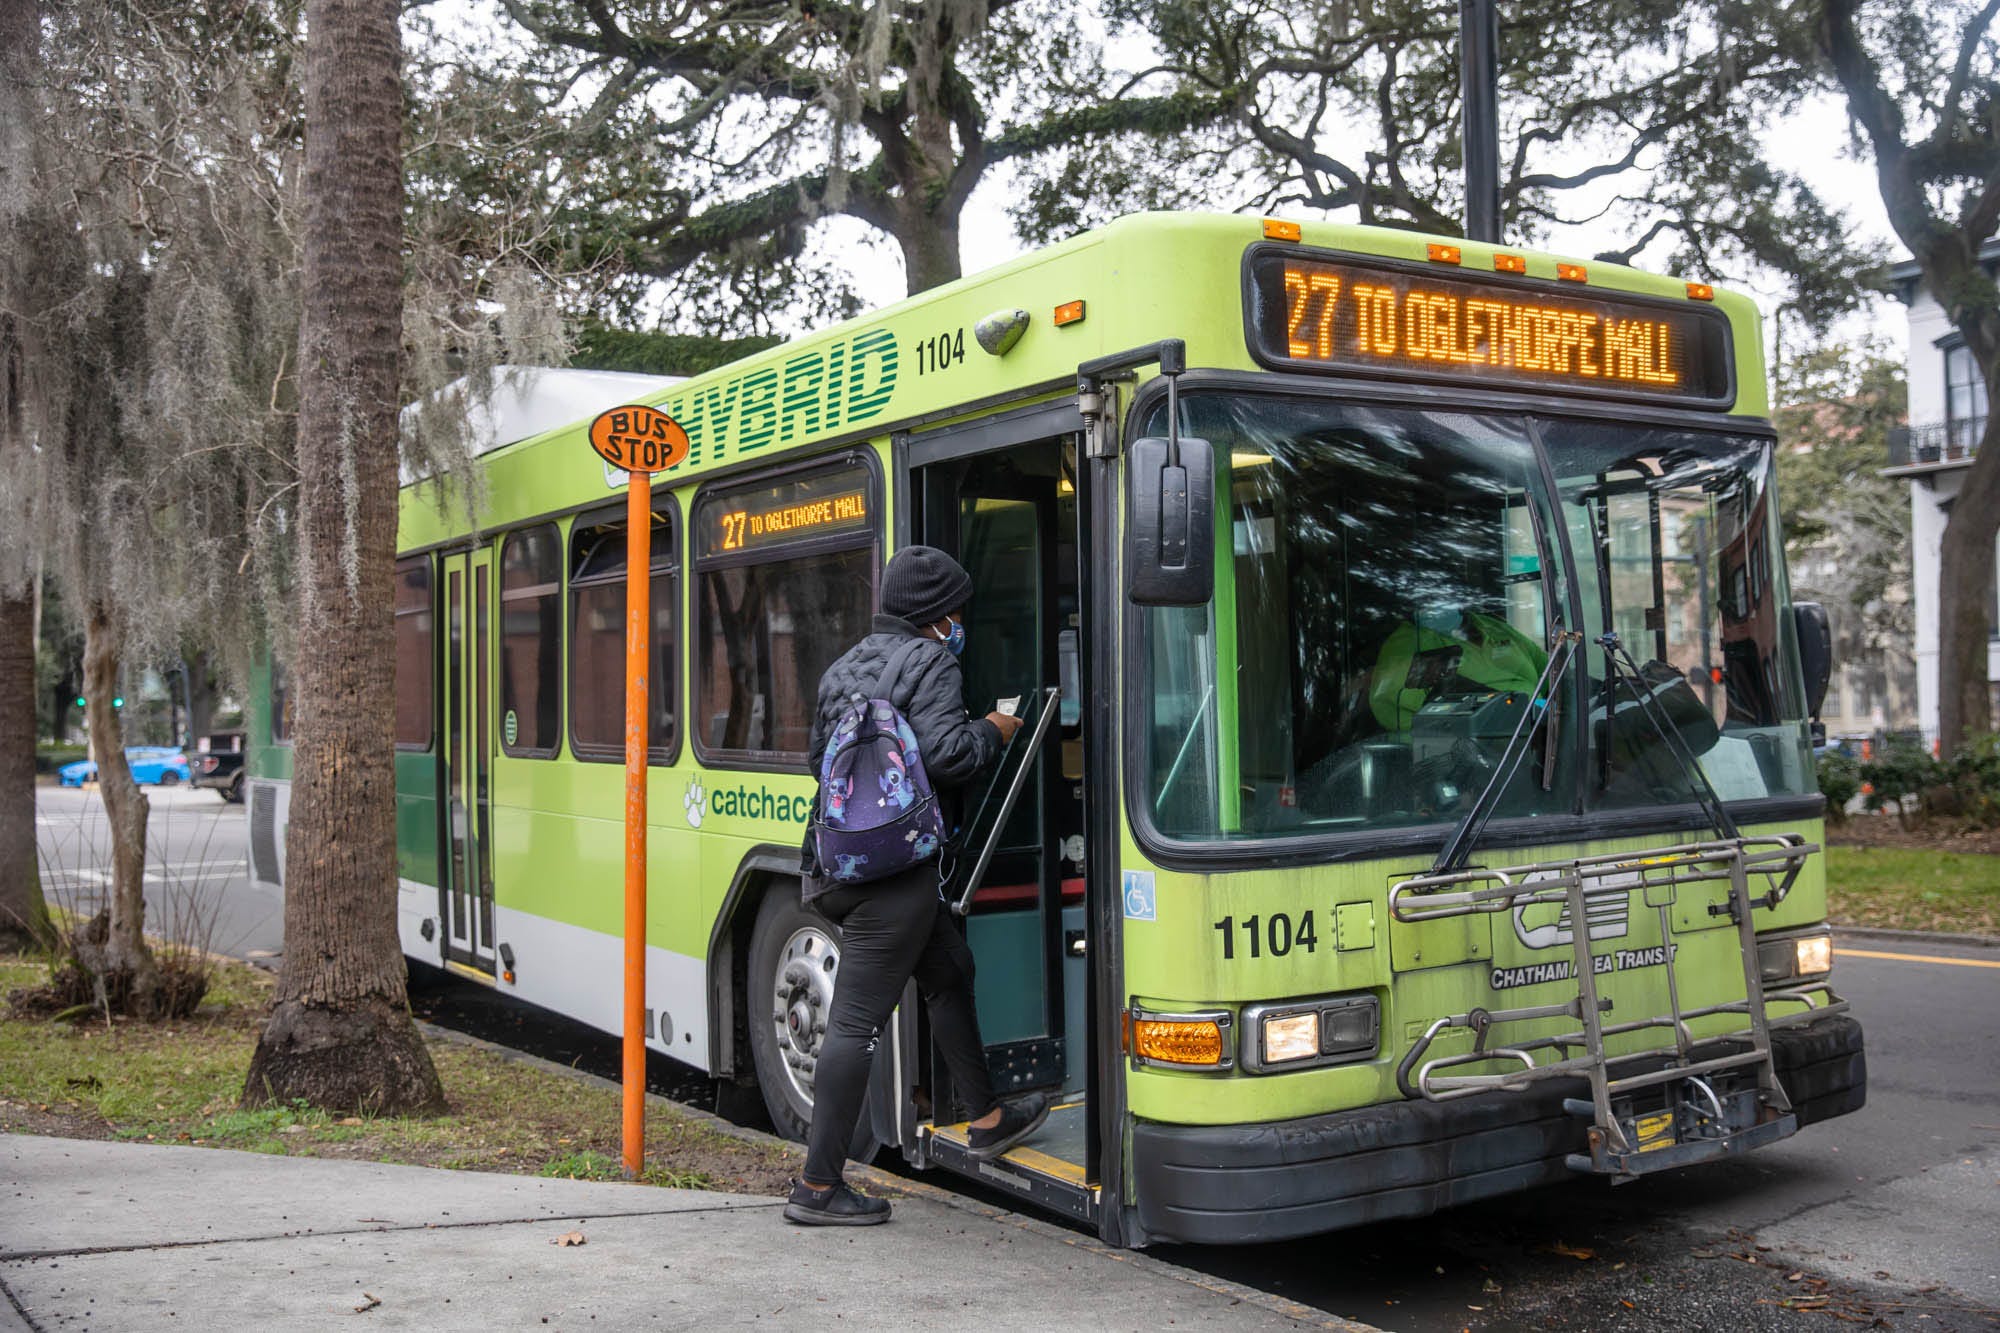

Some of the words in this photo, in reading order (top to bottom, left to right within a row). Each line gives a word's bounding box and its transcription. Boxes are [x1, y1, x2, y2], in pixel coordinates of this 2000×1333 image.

[916, 327, 965, 376] 1104
[1285, 271, 1339, 358] 27
[1353, 285, 1395, 353] TO
[1406, 293, 1598, 375] OGLETHORPE
[1605, 317, 1677, 383] MALL
[610, 410, 670, 439] BUS
[604, 435, 673, 468] STOP
[722, 511, 746, 549] 27
[749, 516, 763, 535] TO
[765, 501, 832, 532] OGLETHORPE
[834, 495, 865, 520] MALL
[1214, 909, 1318, 959] 1104
[1491, 960, 1570, 990] CHATHAM
[1571, 953, 1614, 978] EA
[1616, 944, 1678, 971] TRANST
